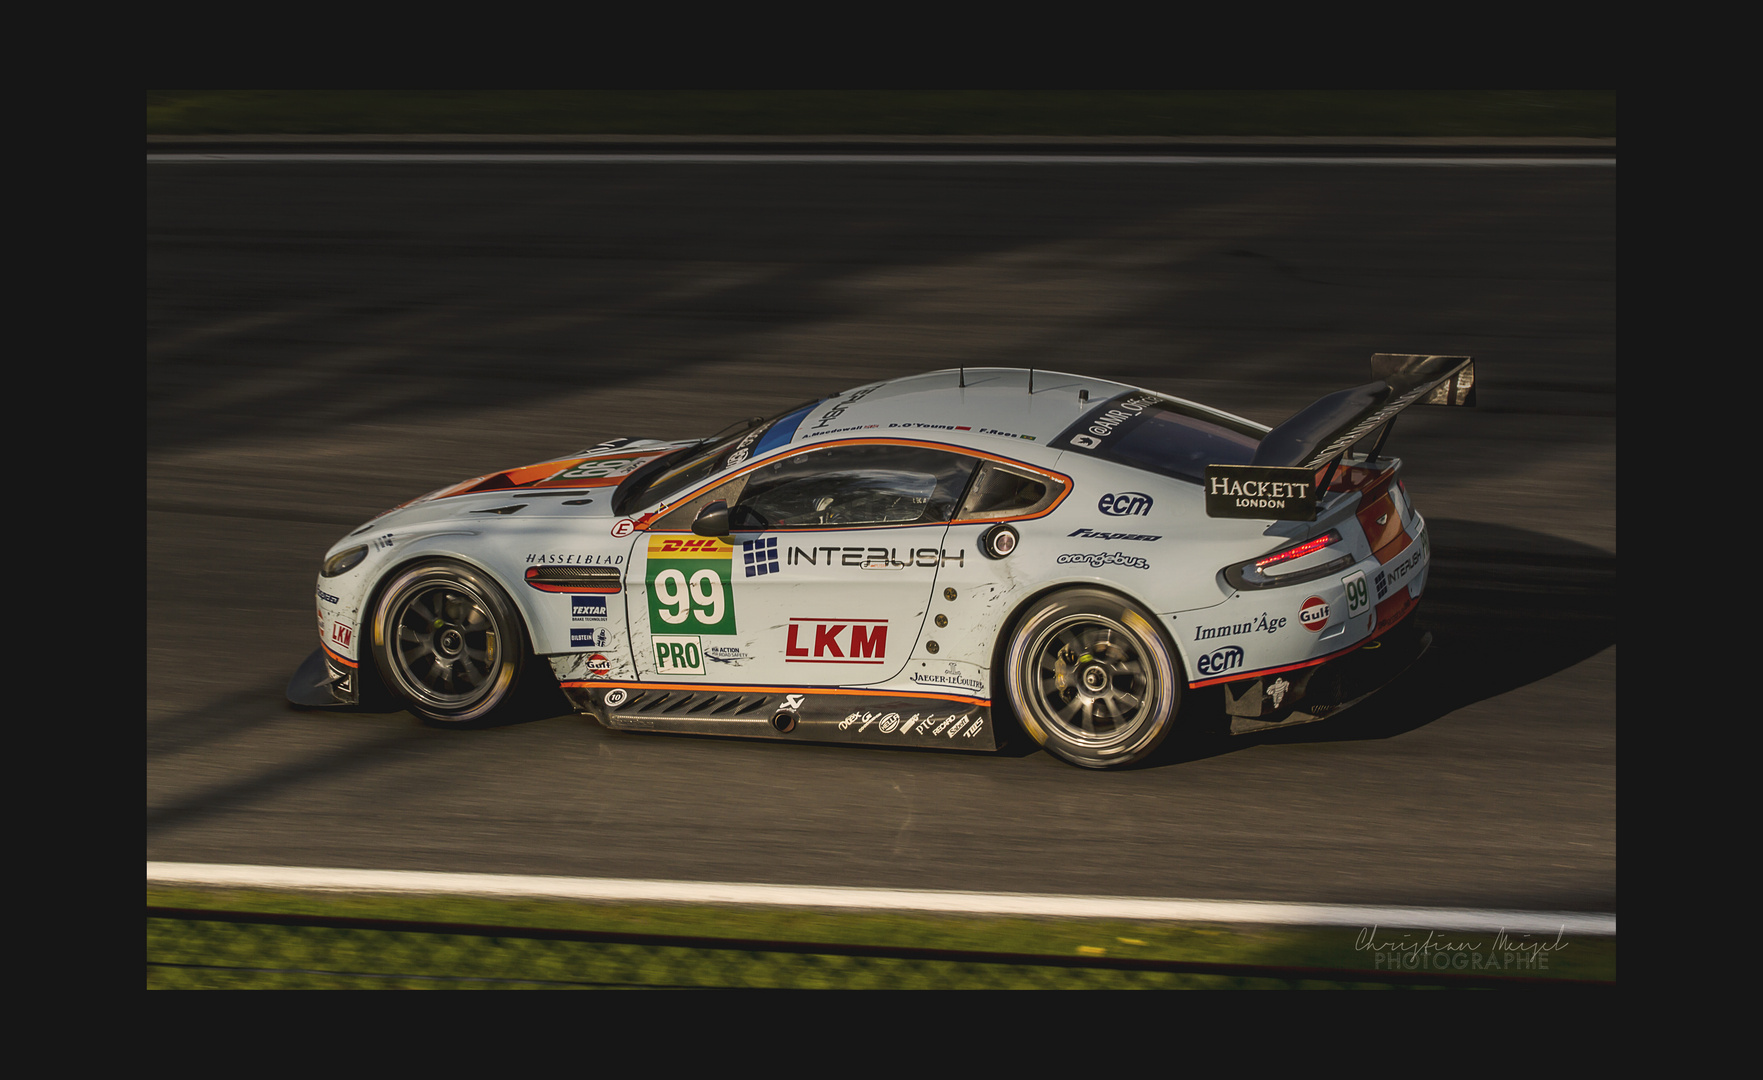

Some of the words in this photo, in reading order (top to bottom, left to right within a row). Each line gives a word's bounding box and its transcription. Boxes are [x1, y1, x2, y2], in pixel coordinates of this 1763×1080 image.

[1210, 477, 1310, 499] HACKETT
[1098, 491, 1154, 517] ecm
[1235, 498, 1286, 509] LONDON
[660, 539, 724, 553] DHL
[786, 545, 965, 569] INTERUSH
[525, 553, 625, 565] HASSELBLAD
[653, 568, 726, 626] 99
[1346, 577, 1368, 611] 99
[572, 605, 607, 615] TEXTAR
[1299, 605, 1331, 623] Gulf
[332, 623, 352, 647] LKM
[785, 623, 889, 659] LKM
[657, 641, 700, 669] PRO
[1197, 645, 1245, 676] ecm
